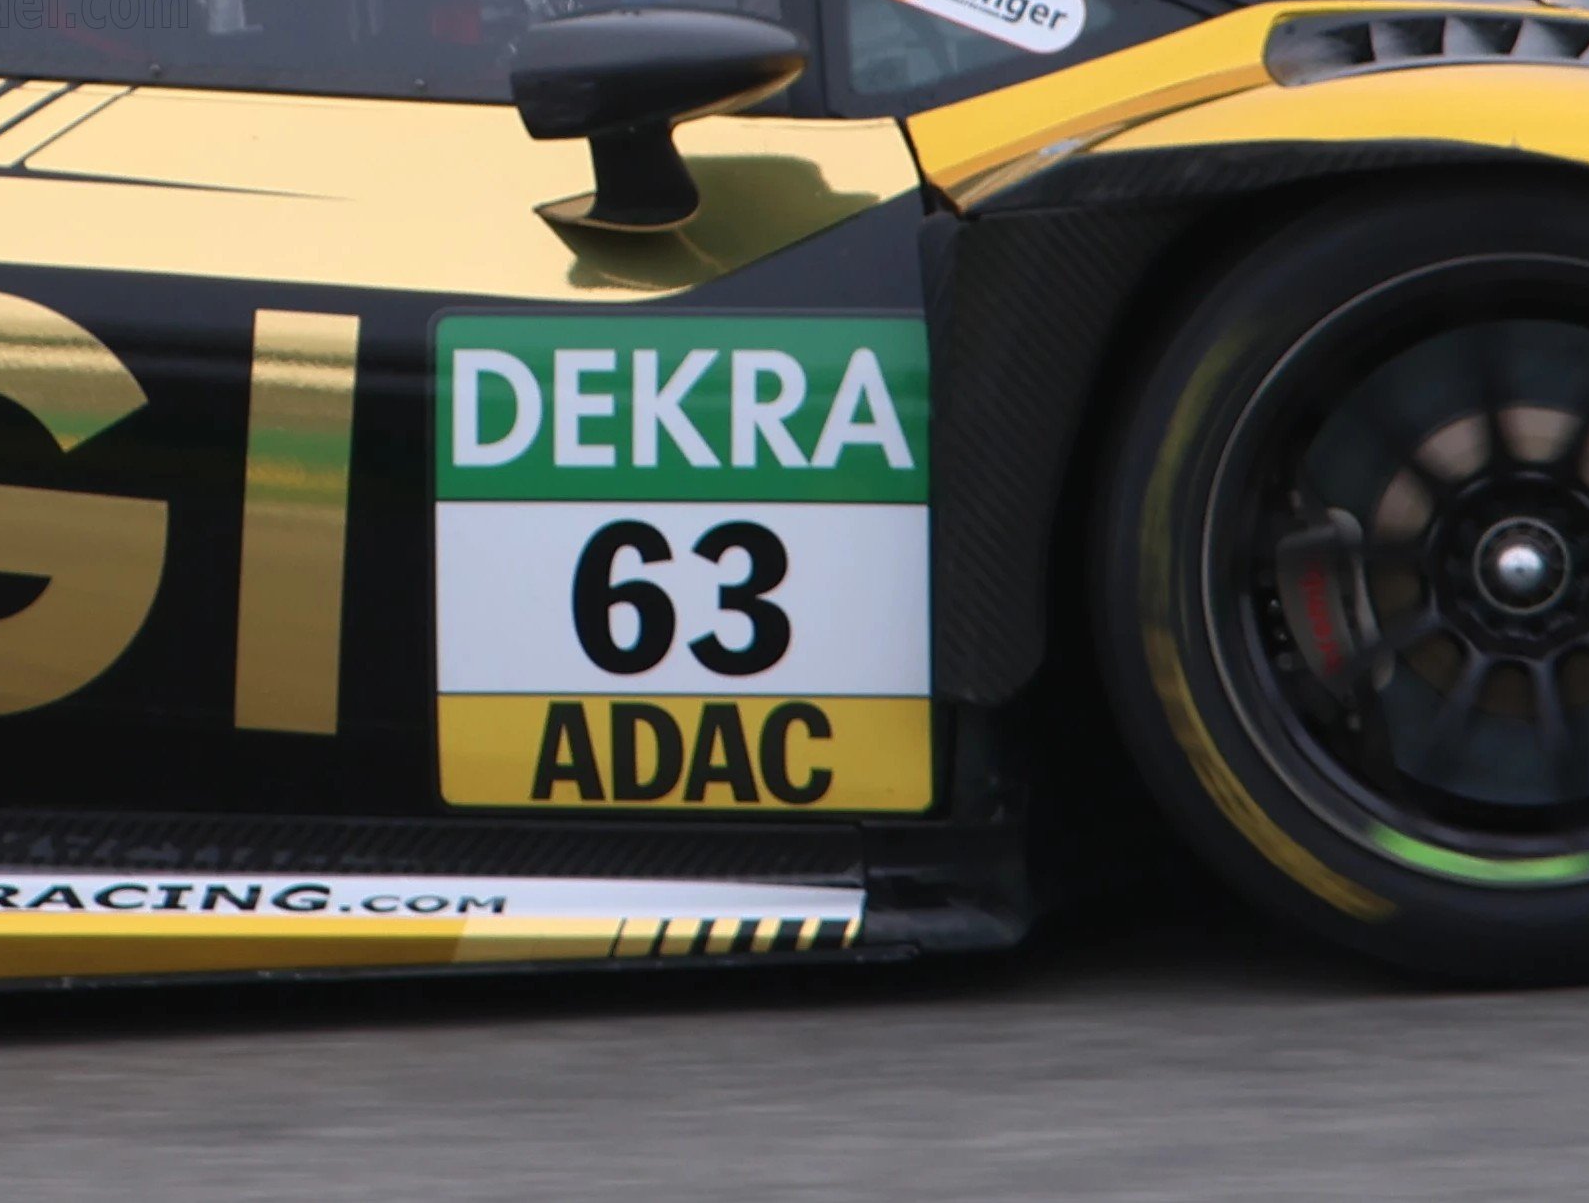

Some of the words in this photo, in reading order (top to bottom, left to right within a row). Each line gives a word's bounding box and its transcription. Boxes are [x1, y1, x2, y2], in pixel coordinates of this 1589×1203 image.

[450, 345, 917, 474] DEKRA
[569, 518, 793, 679] 63
[528, 701, 835, 806] ADAC
